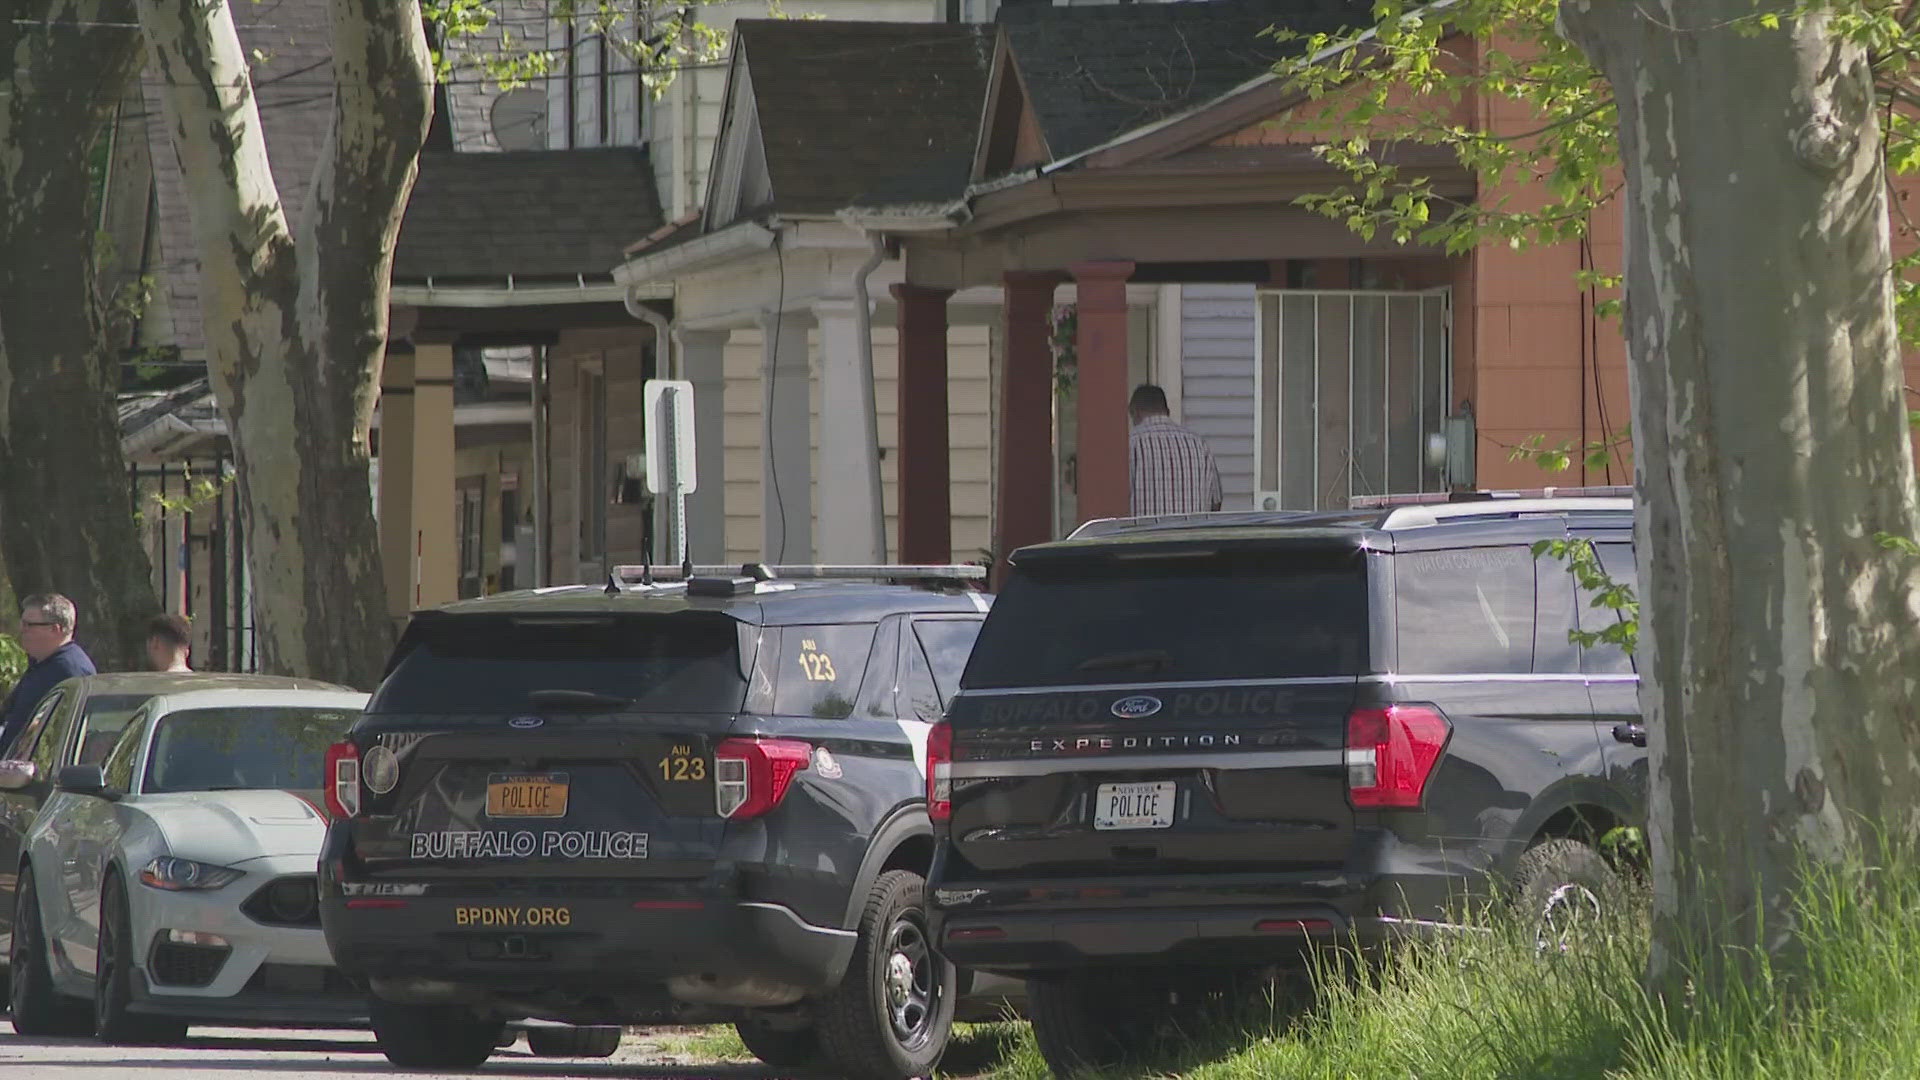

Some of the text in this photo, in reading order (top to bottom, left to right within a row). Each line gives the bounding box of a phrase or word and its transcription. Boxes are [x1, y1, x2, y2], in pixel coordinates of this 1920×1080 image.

[799, 653, 836, 681] 123
[980, 690, 1296, 723] BUFFALO POLICE
[672, 745, 691, 755] AIU
[1030, 734, 1242, 751] EXPEDITION
[658, 757, 706, 781] 123
[502, 786, 551, 808] POLICE
[1118, 786, 1134, 794] NEW
[1110, 794, 1159, 818] POLICE
[411, 831, 649, 859] BUFFALO POLICE
[456, 907, 570, 926] BPDNY.ORG
